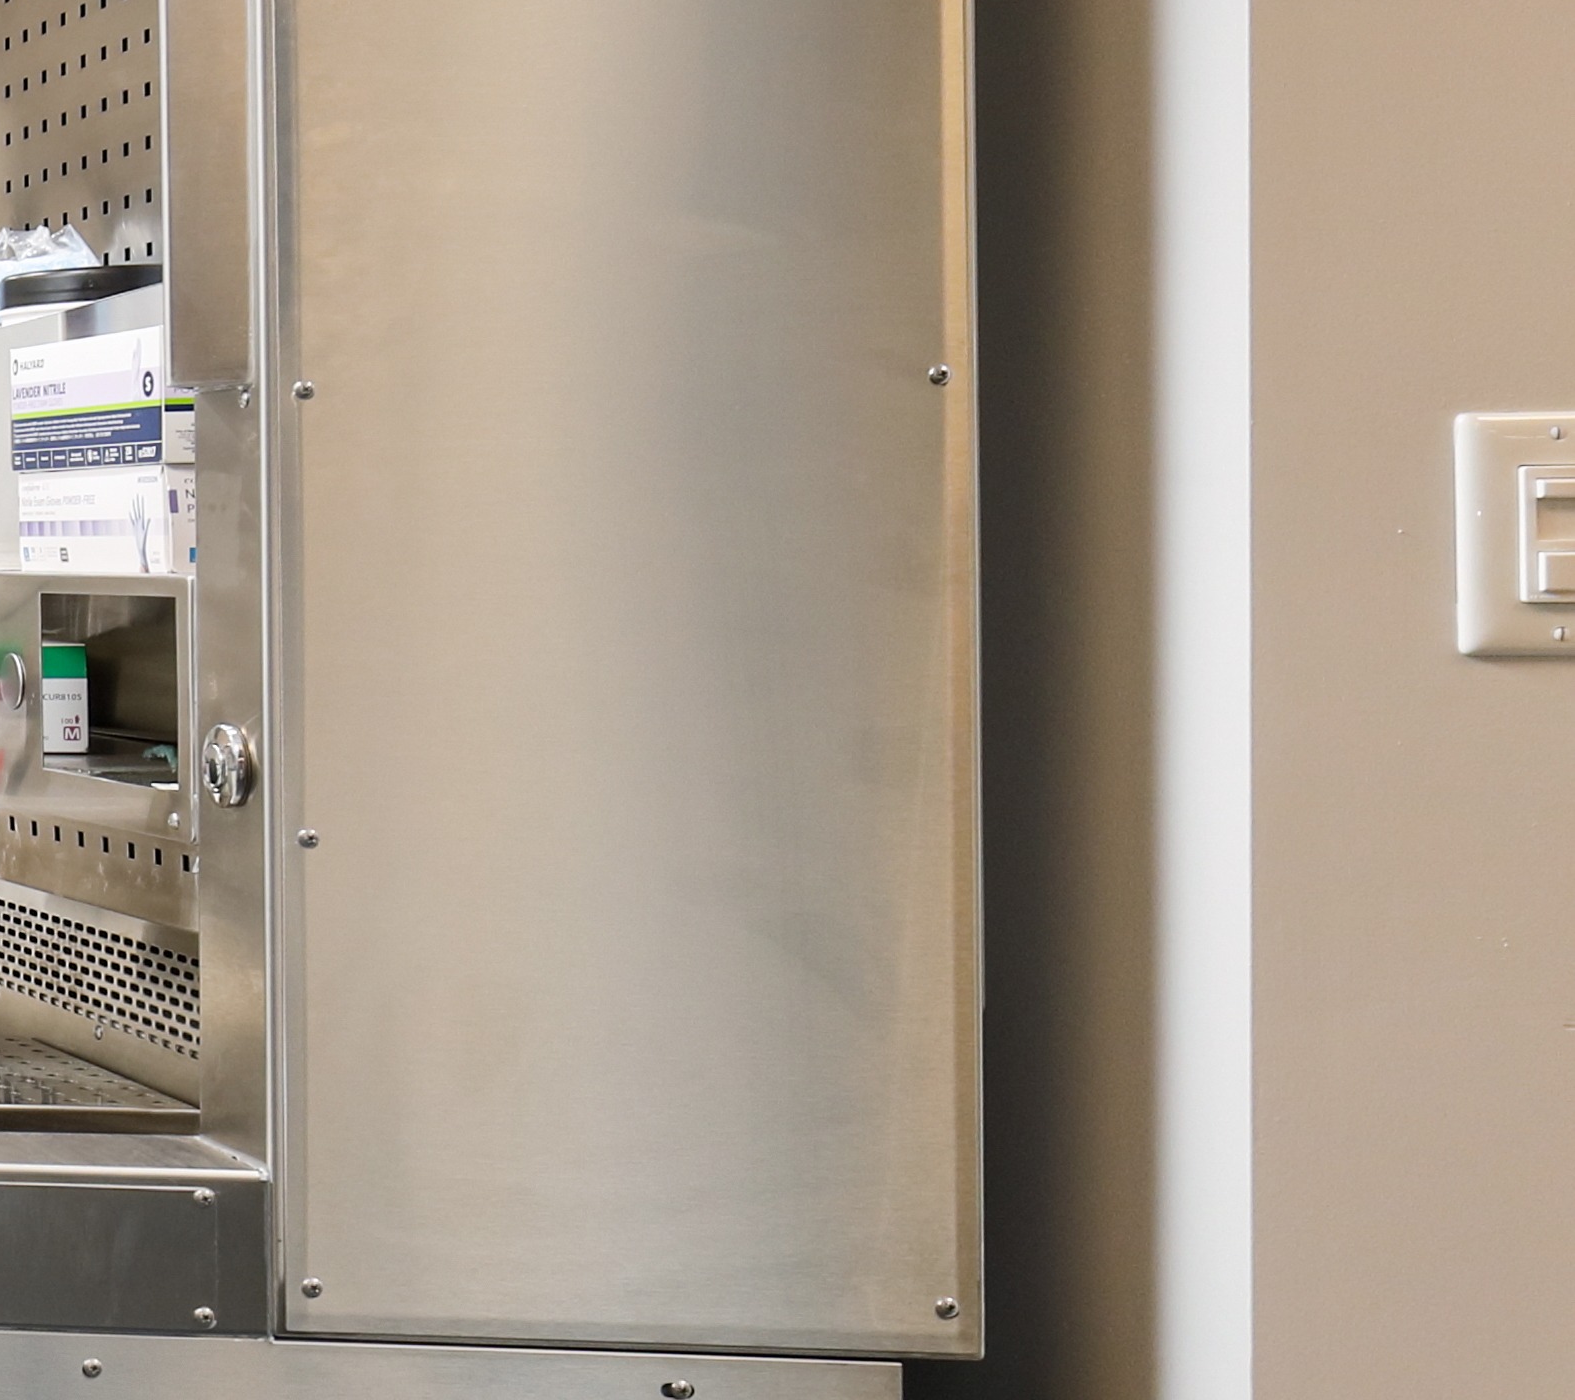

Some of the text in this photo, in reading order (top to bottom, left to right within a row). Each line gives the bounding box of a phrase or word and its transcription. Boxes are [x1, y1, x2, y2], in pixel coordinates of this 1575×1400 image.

[19, 358, 45, 370] HALYARD
[12, 382, 67, 400] LAVENDER NITRILE
[64, 727, 81, 740] M
